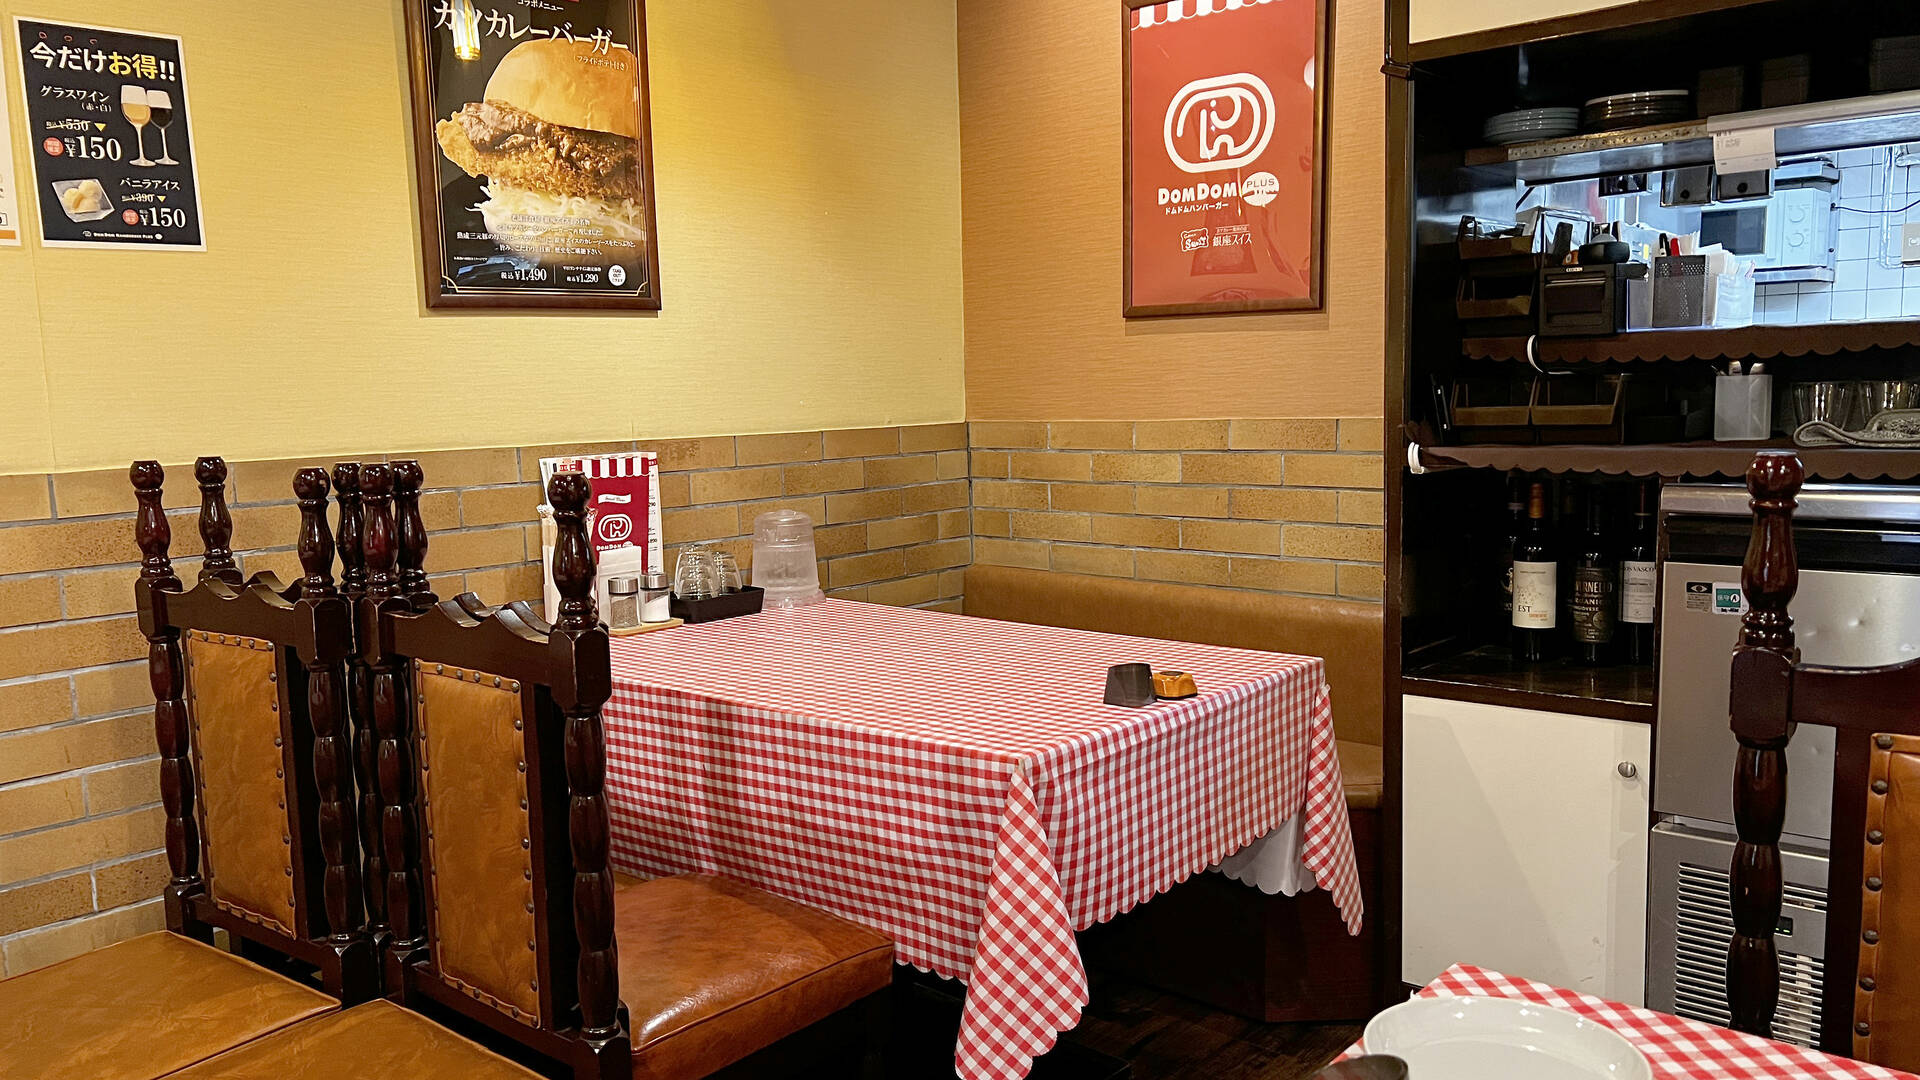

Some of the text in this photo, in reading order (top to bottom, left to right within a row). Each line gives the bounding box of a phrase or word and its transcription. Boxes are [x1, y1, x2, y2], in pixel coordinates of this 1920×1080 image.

[29, 41, 175, 81] 今だけお得!!
[40, 85, 110, 102] グラスワイン
[65, 136, 121, 161] ¥150
[120, 177, 180, 190] バニラアイス
[1247, 178, 1275, 188] PLUS
[1158, 182, 1238, 205] DOMDOM
[1165, 201, 1229, 215] ドムドムハンバーガー
[140, 207, 186, 228] ¥150
[1212, 233, 1252, 247] 銀座スイス
[515, 268, 547, 281] ¥1,490
[1518, 605, 1531, 613] EST
